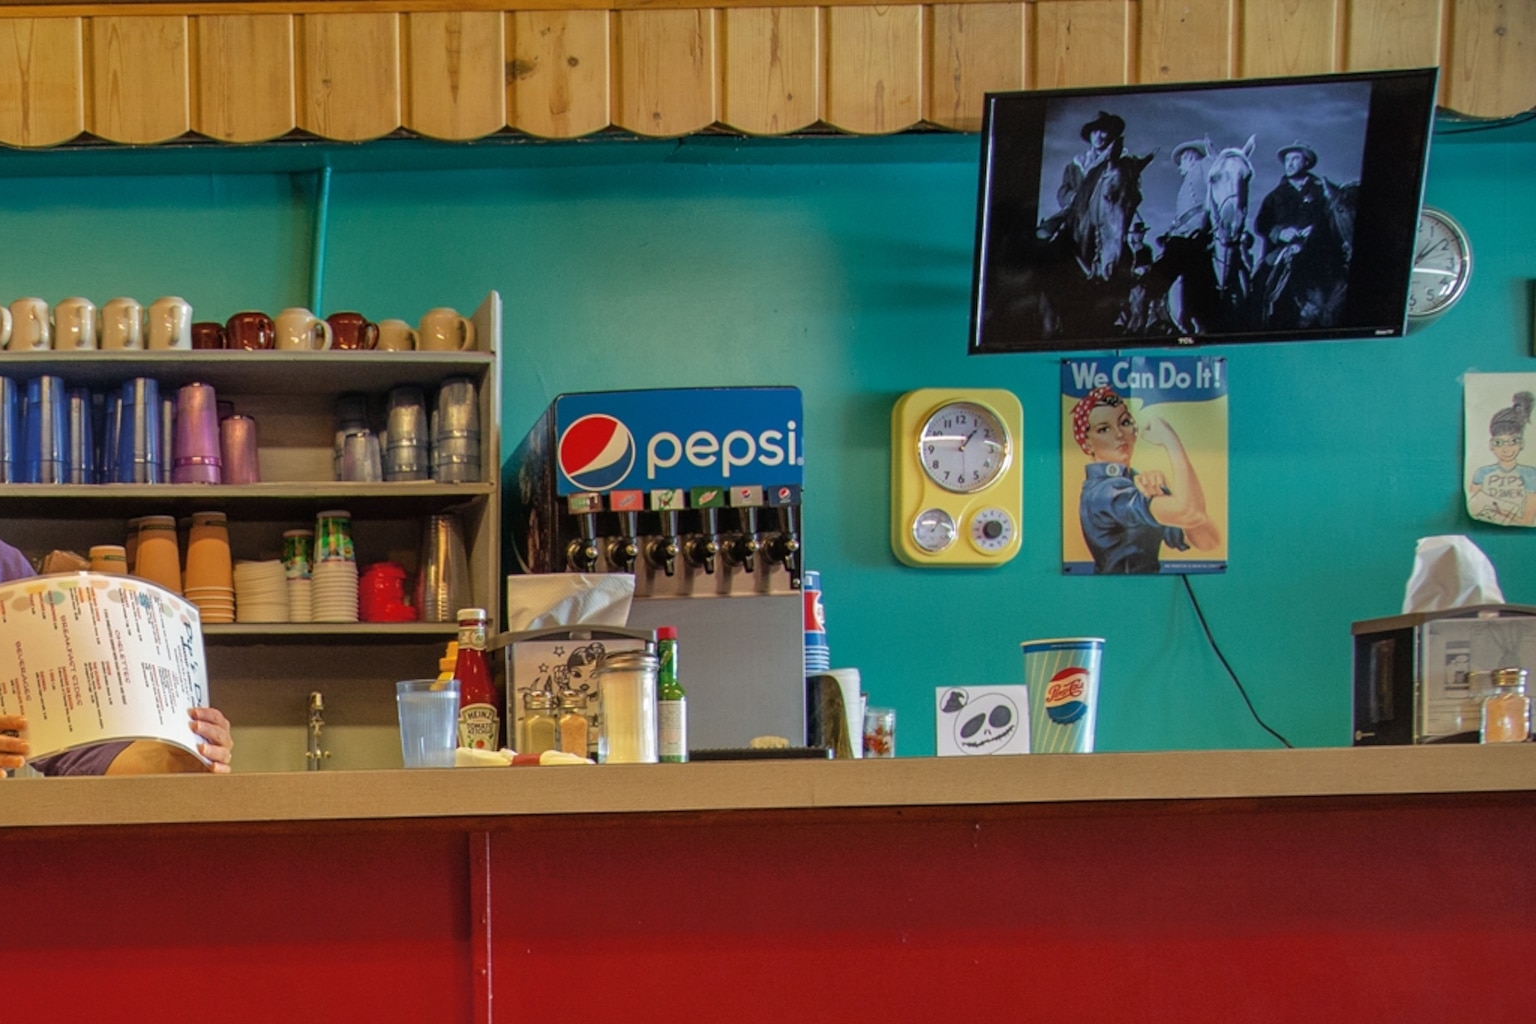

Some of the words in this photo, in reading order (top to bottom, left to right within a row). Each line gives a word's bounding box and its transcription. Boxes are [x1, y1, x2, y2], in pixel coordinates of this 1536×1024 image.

[1071, 362, 1109, 389] We
[1113, 361, 1155, 389] Can
[1159, 361, 1191, 389] Do
[1196, 361, 1221, 389] It!
[944, 419, 951, 429] 11
[956, 415, 966, 424] 12
[984, 429, 990, 438] 2
[647, 419, 797, 480] pepsi
[928, 445, 935, 454] 9
[988, 445, 994, 454] 3
[932, 460, 939, 469] 8
[944, 471, 950, 480] 7
[958, 475, 965, 484] 6
[973, 471, 979, 480] 5
[183, 621, 199, 674] Pip's
[60, 615, 77, 673] BREAKFAST
[71, 674, 83, 707] SIDES
[115, 629, 131, 684] OMELETTES
[15, 640, 32, 702] BEVERAGES
[467, 710, 493, 720] HEINZ
[466, 722, 494, 731] TOMATO
[467, 728, 493, 736] KETCHUP
